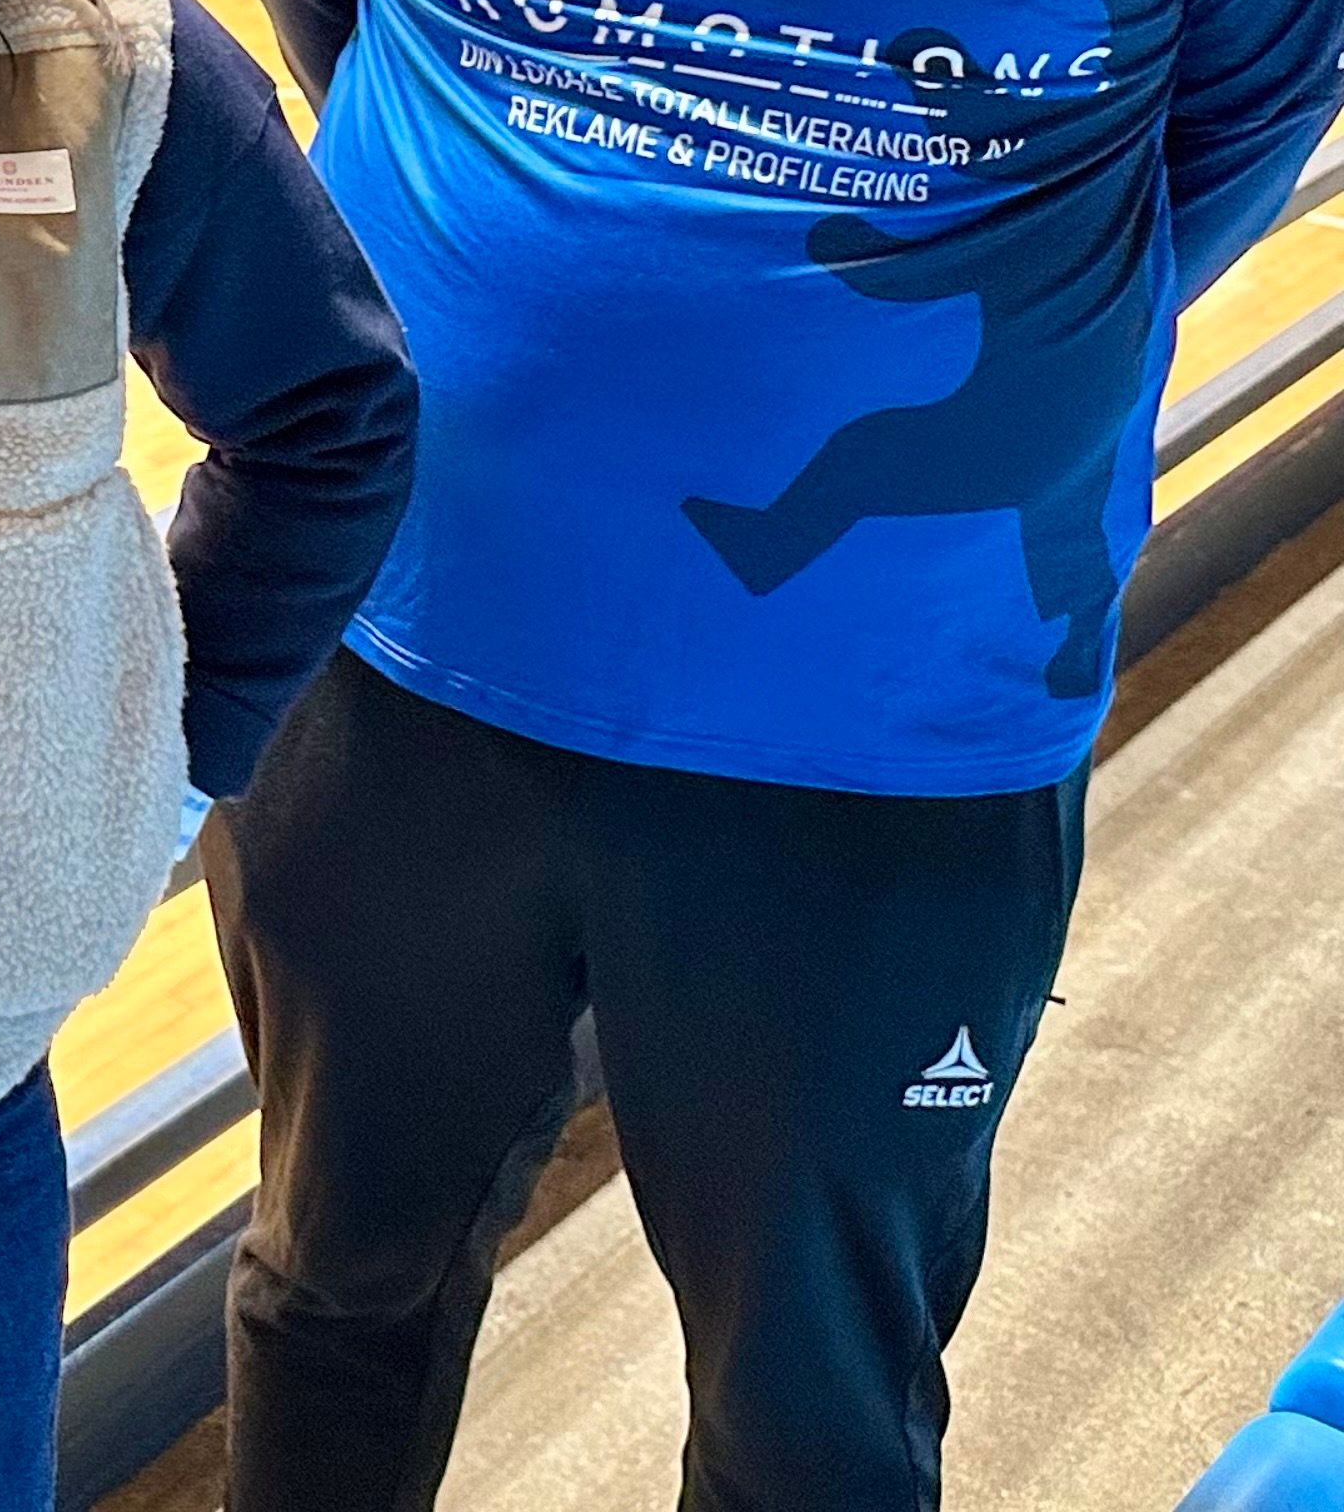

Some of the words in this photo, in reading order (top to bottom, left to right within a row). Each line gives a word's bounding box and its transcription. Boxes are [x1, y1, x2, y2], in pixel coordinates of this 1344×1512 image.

[508, 95, 664, 159] REKLAME
[667, 133, 696, 167] &
[704, 139, 930, 202] PROFILERING
[902, 1082, 994, 1107] SELECT
